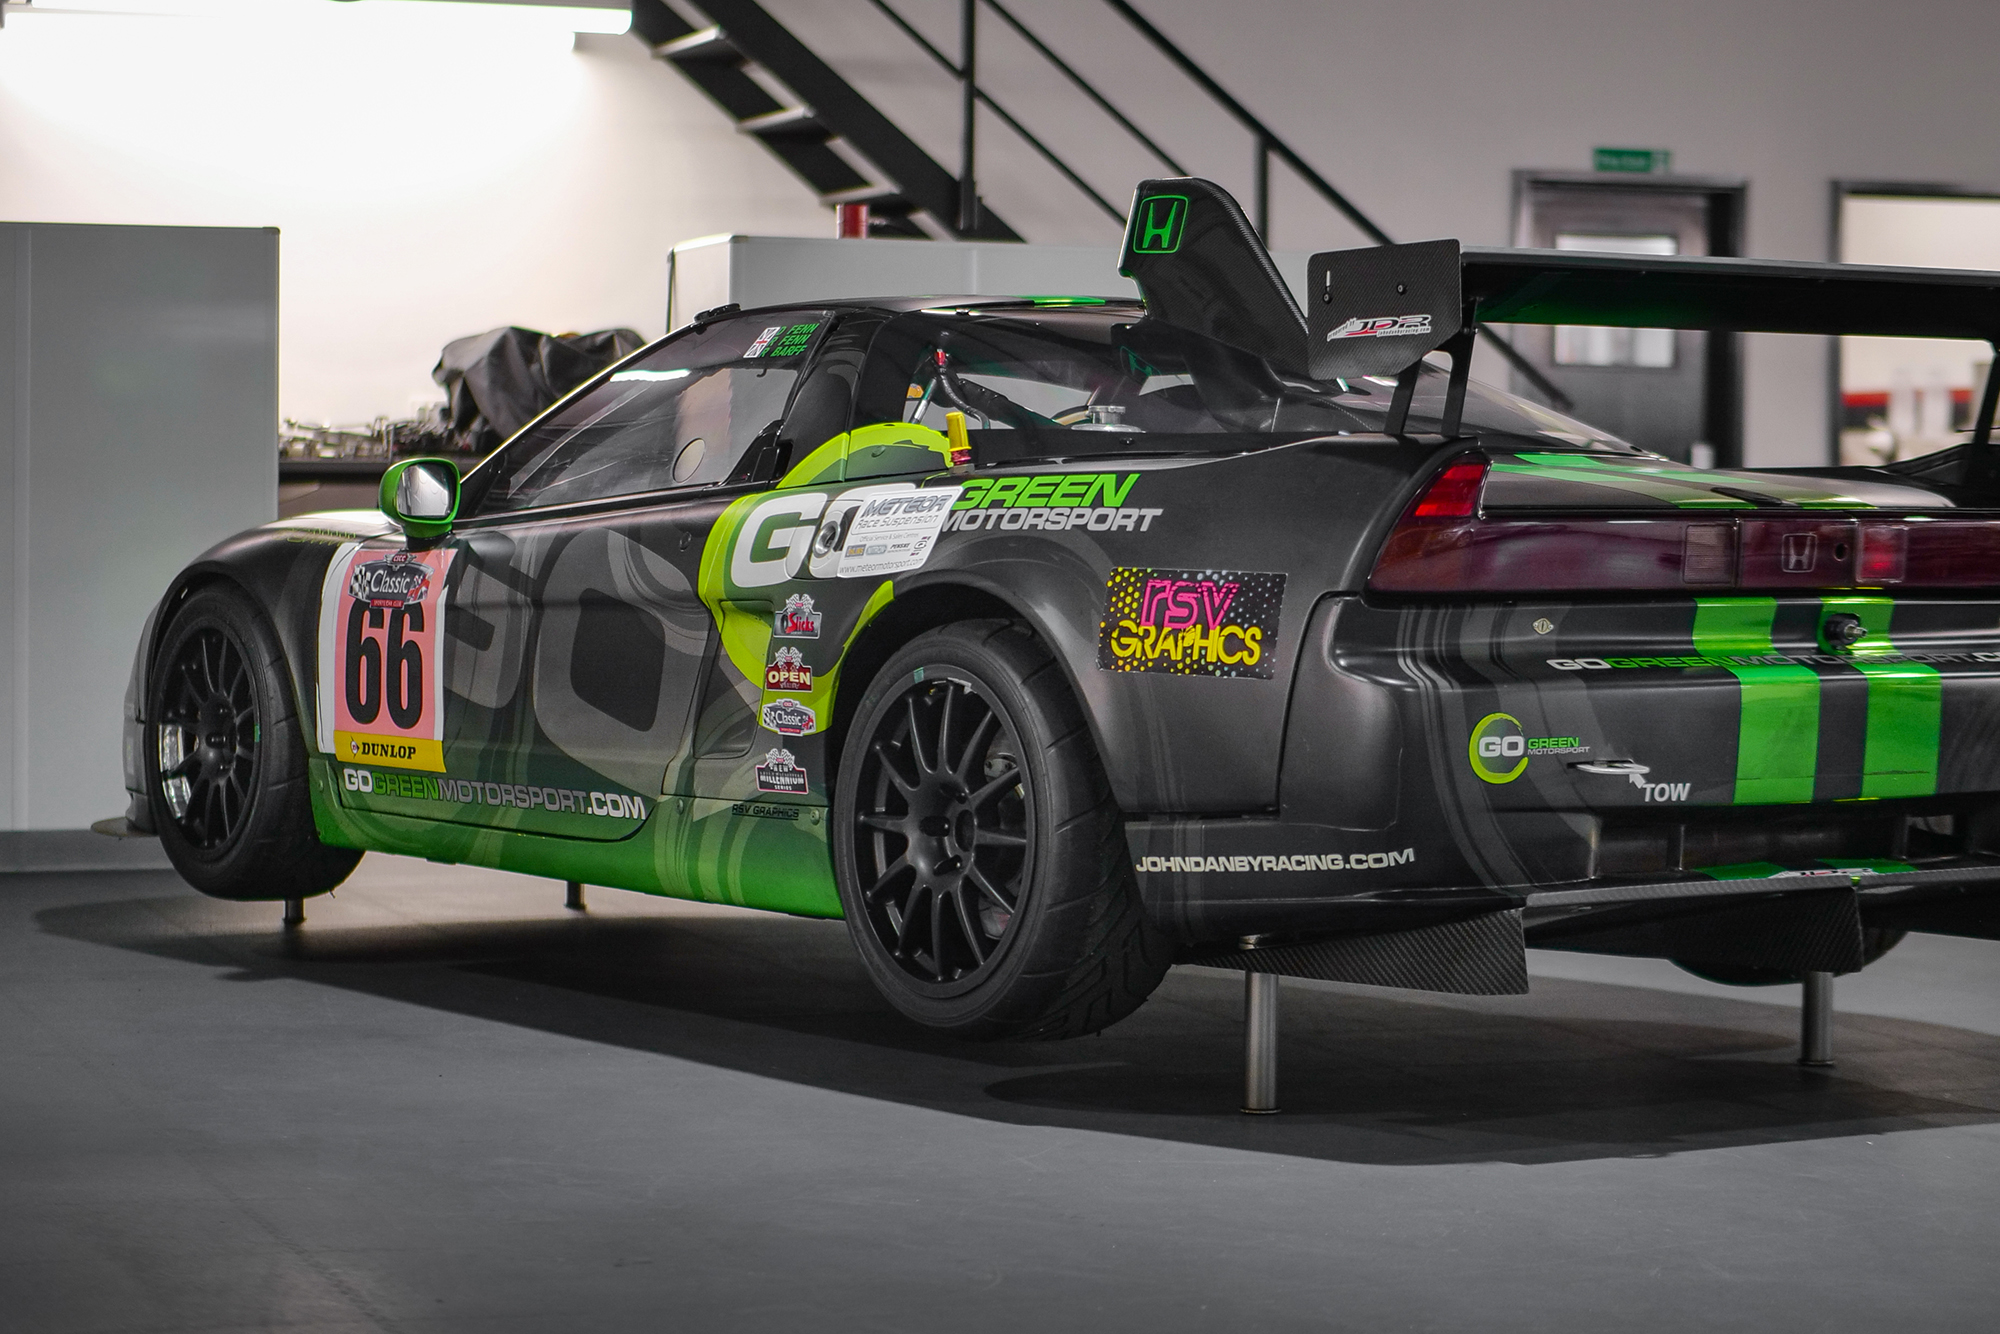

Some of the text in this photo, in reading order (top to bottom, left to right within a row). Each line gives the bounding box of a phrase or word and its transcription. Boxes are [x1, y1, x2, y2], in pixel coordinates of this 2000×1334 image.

[776, 322, 820, 336] D FENN
[767, 333, 812, 346] R FENN
[759, 344, 808, 357] R BARFF
[951, 473, 1141, 510] GREEN
[860, 494, 953, 518] METEOR
[854, 513, 939, 530] Race Suspension
[941, 507, 1164, 532] MOTORSPORT
[370, 569, 411, 594] Classic
[785, 612, 814, 634] Slicks
[1111, 619, 1263, 666] GRAPHICS
[345, 599, 425, 730] 66
[1546, 651, 2000, 671] GOGREENMOTORSPORT.C
[768, 671, 811, 686] OPEN
[775, 710, 802, 726] Classic
[361, 742, 416, 760] DUNLOP
[1479, 736, 1525, 757] GO
[1527, 737, 1580, 748] GREEN
[1527, 746, 1590, 756] MOTORSPORT
[773, 764, 789, 773] NEW
[759, 774, 805, 785] MILLENNIUM
[1644, 782, 1691, 802] TOW
[731, 803, 800, 818] RSV GRAPHICS
[1135, 848, 1415, 872] JOHNDANBYRACING.COM
